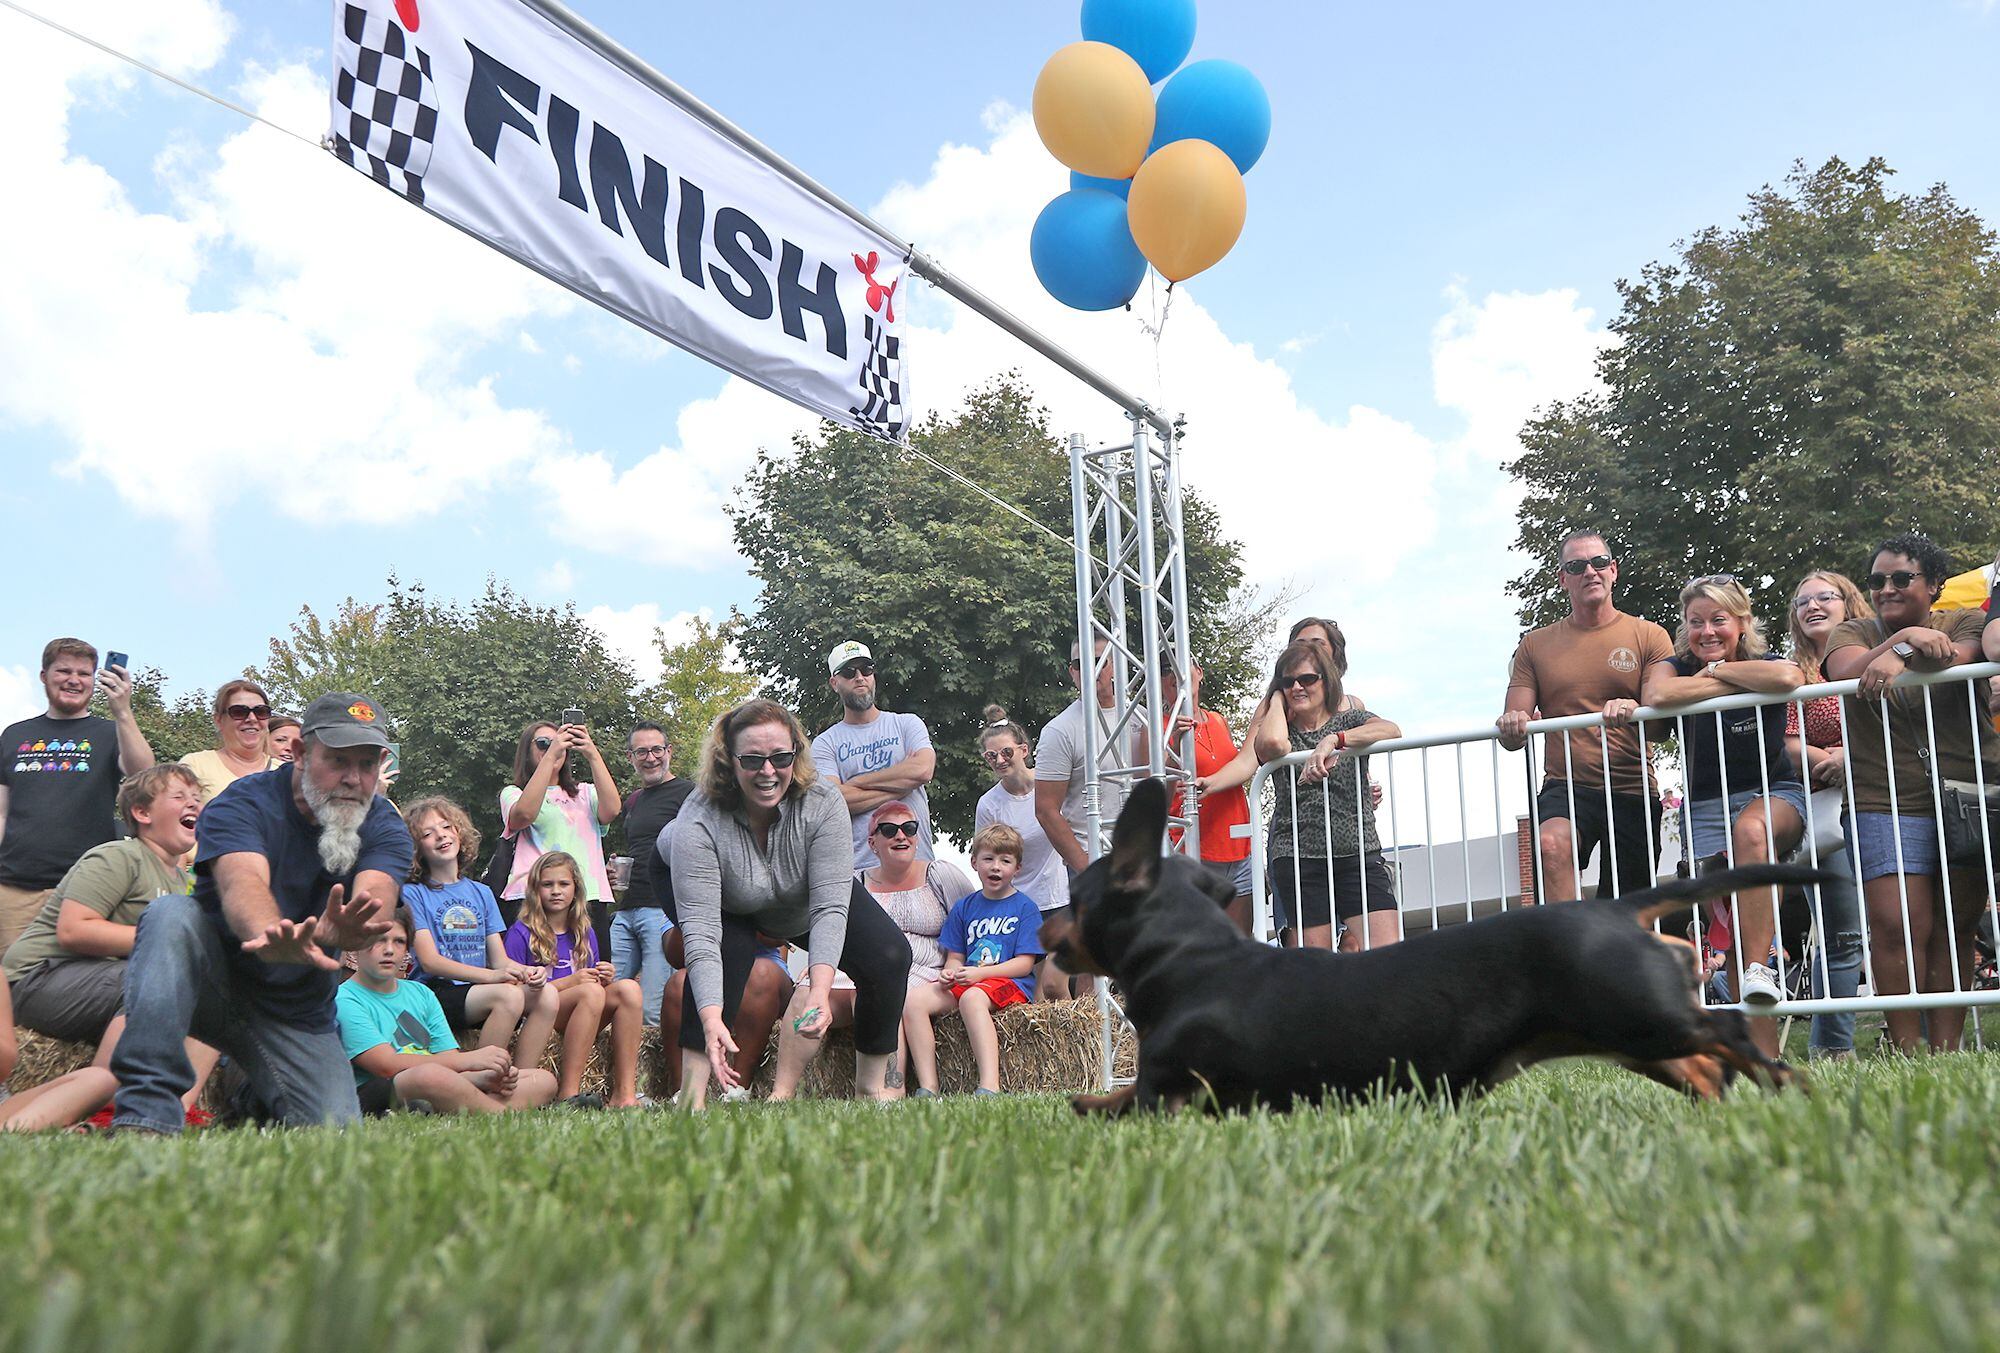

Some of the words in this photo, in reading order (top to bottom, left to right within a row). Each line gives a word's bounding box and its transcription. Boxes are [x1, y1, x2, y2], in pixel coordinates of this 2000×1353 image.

[464, 37, 848, 361] FINISH
[838, 736, 899, 762] Champion
[863, 749, 893, 770] City
[966, 916, 1019, 945] SONIC
